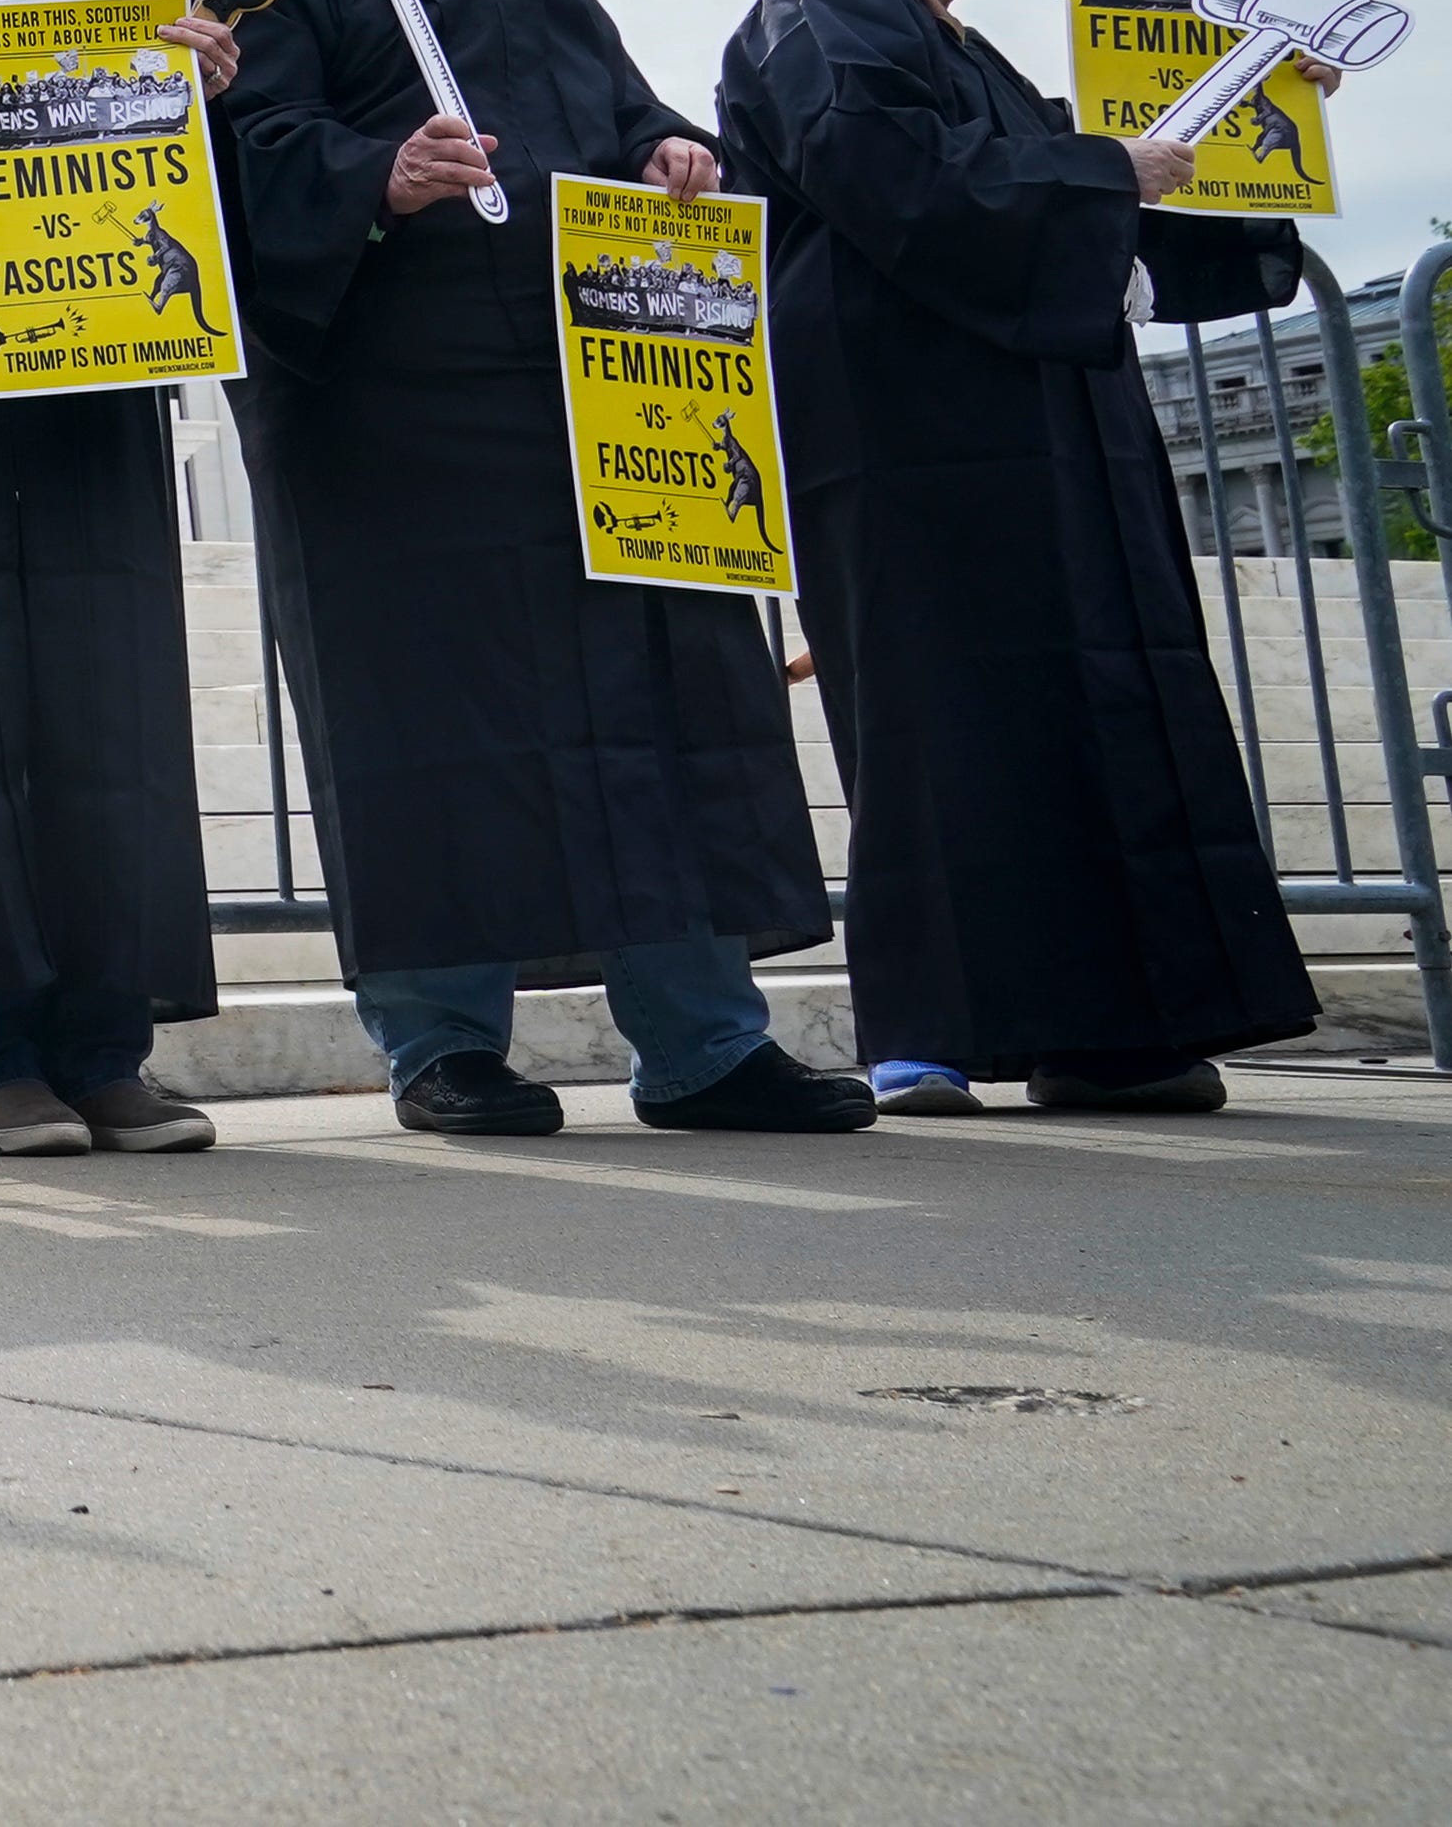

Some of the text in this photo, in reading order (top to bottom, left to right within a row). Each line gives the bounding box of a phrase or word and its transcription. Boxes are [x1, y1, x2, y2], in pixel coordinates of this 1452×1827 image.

[2, 11, 39, 28] HEAR
[43, 9, 80, 26] THIS,
[86, 5, 150, 24] SCOTUS!!
[18, 31, 45, 47] NOT
[54, 28, 102, 45] ABOVE
[108, 26, 138, 42] THE
[1089, 13, 1295, 61] FEMINI
[47, 99, 98, 129] WAVE
[110, 97, 183, 125] RISING
[1198, 180, 1230, 197] NOT
[1235, 182, 1310, 199] IMMUNE!
[586, 191, 732, 224] NOW HEAR THIS, SCOTUS!!
[34, 214, 80, 238] -VS-
[564, 208, 752, 244] TRUMP IS NOT ABOVE THE LAW
[578, 286, 751, 329] WOMEN'S WAVE RISING
[4, 337, 213, 372] TRUMP IS NOT IMMUNE!
[580, 336, 753, 396] FEMINISTS
[636, 403, 672, 430] -VS-
[598, 442, 716, 489] FASCISTS
[616, 537, 774, 572] TRUMP IS NOT IMMUNE!
